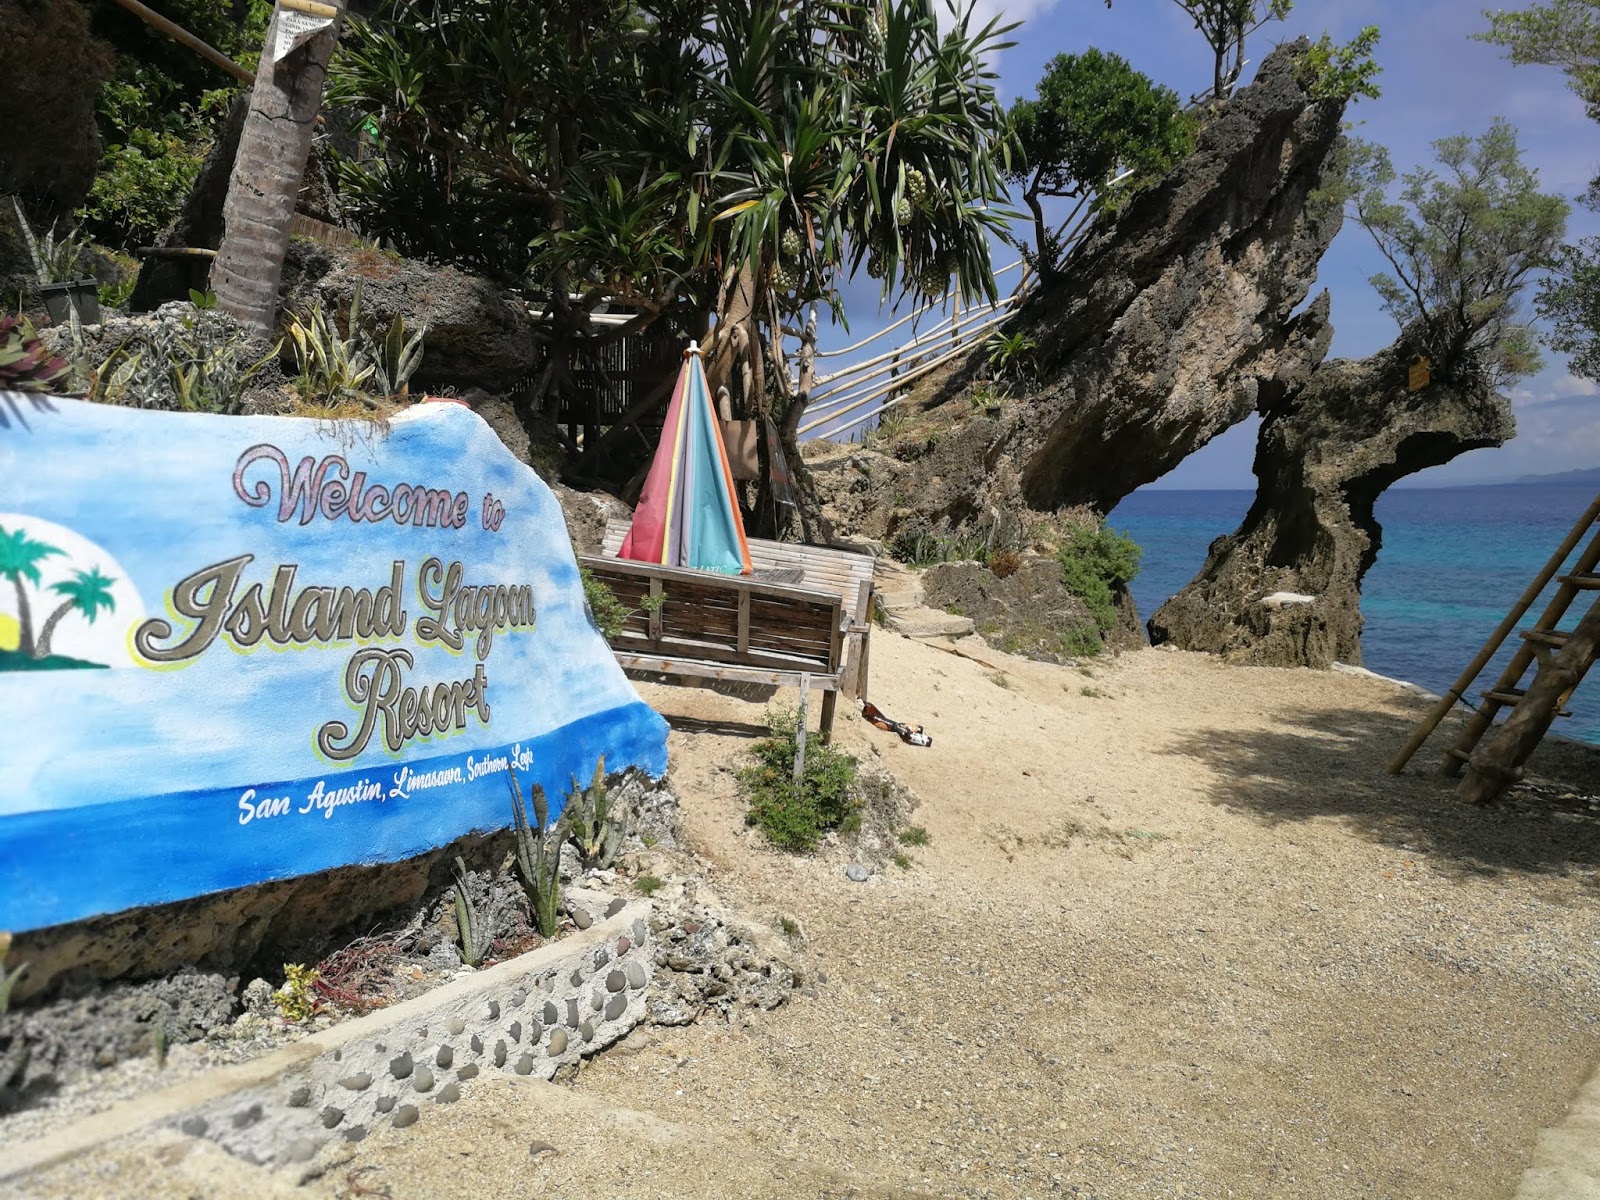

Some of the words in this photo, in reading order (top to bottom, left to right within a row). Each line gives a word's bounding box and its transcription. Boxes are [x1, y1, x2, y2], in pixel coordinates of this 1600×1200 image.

[233, 443, 469, 529] Welcome
[482, 492, 506, 532] to
[134, 553, 407, 662] Island
[415, 557, 537, 661] Lagoon
[318, 647, 491, 760] Resort
[238, 789, 292, 825] San
[298, 780, 386, 819] Agustin,
[467, 754, 509, 782] Southern
